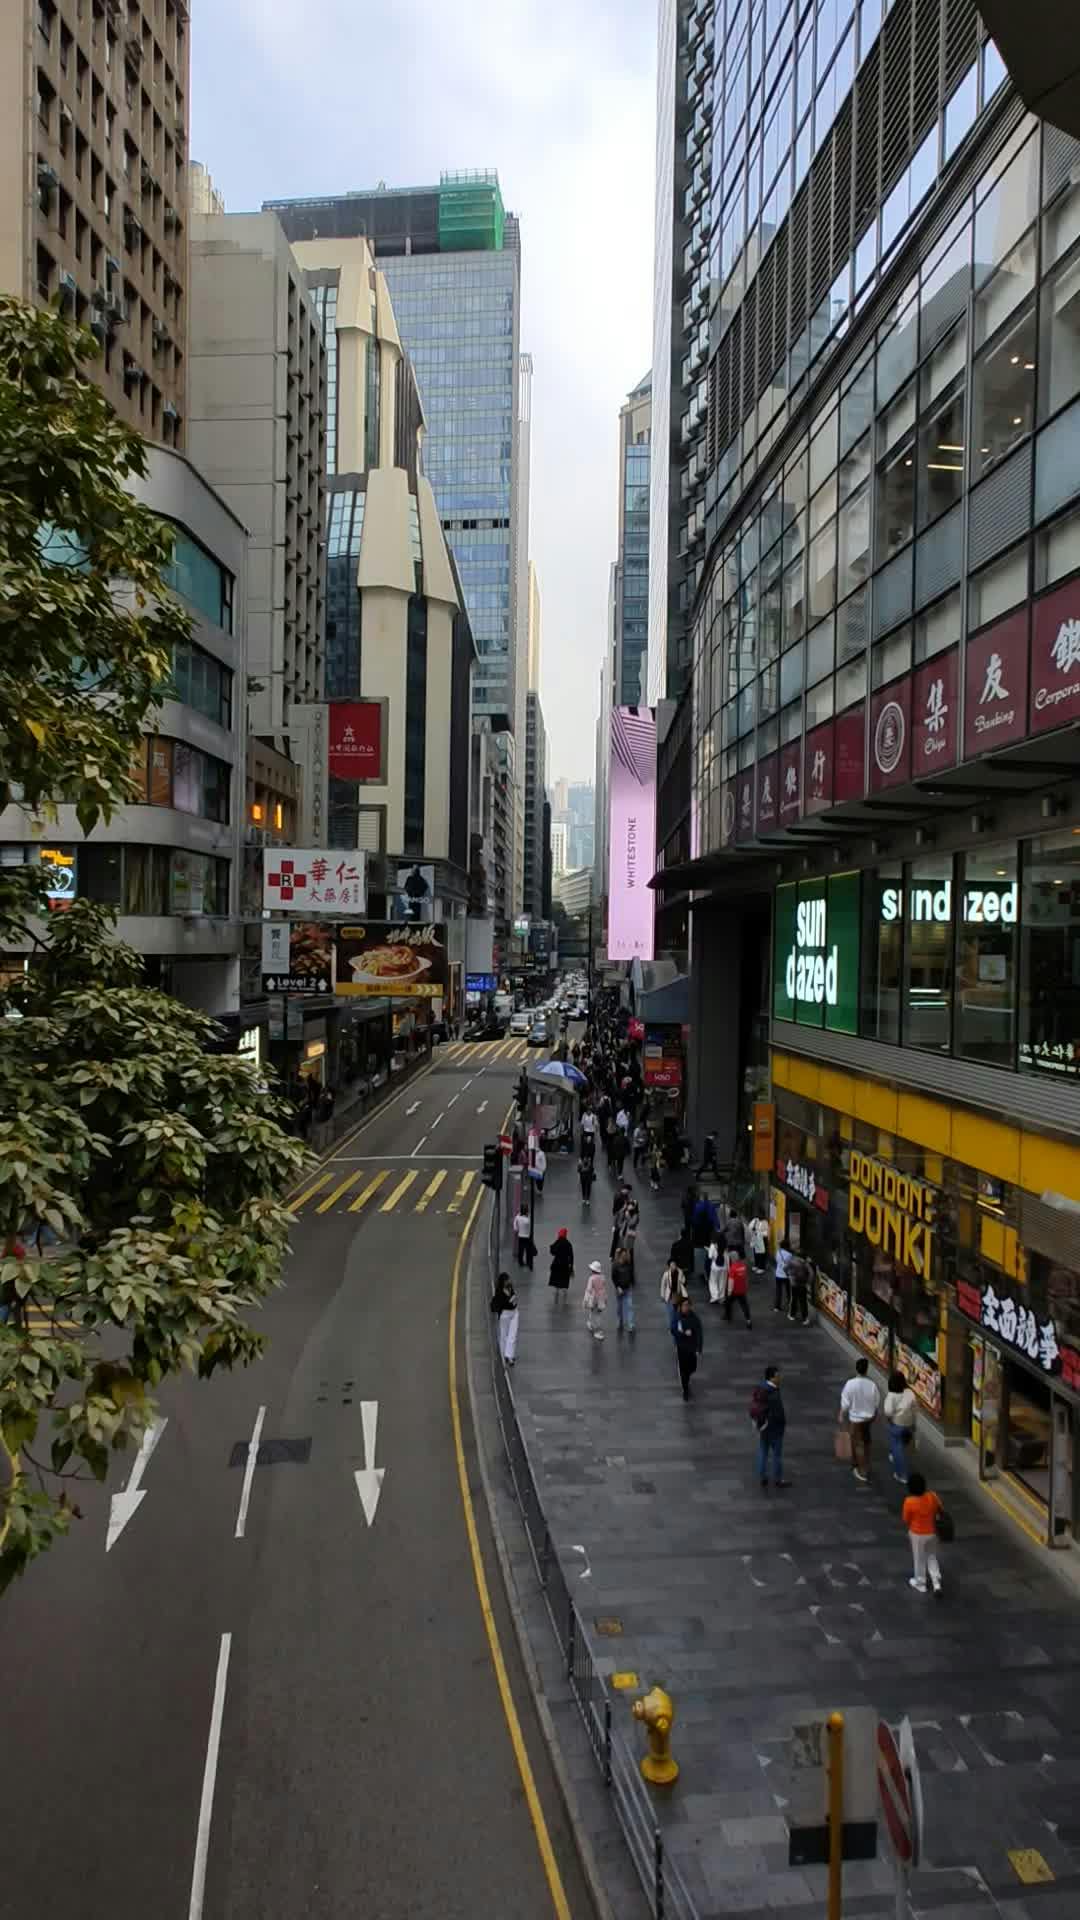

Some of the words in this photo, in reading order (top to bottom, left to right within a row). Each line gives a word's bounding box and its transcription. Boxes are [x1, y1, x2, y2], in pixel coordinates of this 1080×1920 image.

[974, 710, 1015, 734] Banking
[307, 857, 360, 885] 華仁
[627, 816, 637, 889] WHITESTONE
[797, 898, 826, 947] sun
[277, 975, 306, 987] Level
[309, 977, 317, 987] 2
[786, 944, 838, 1004] dazed
[848, 1182, 931, 1280] DONKI
